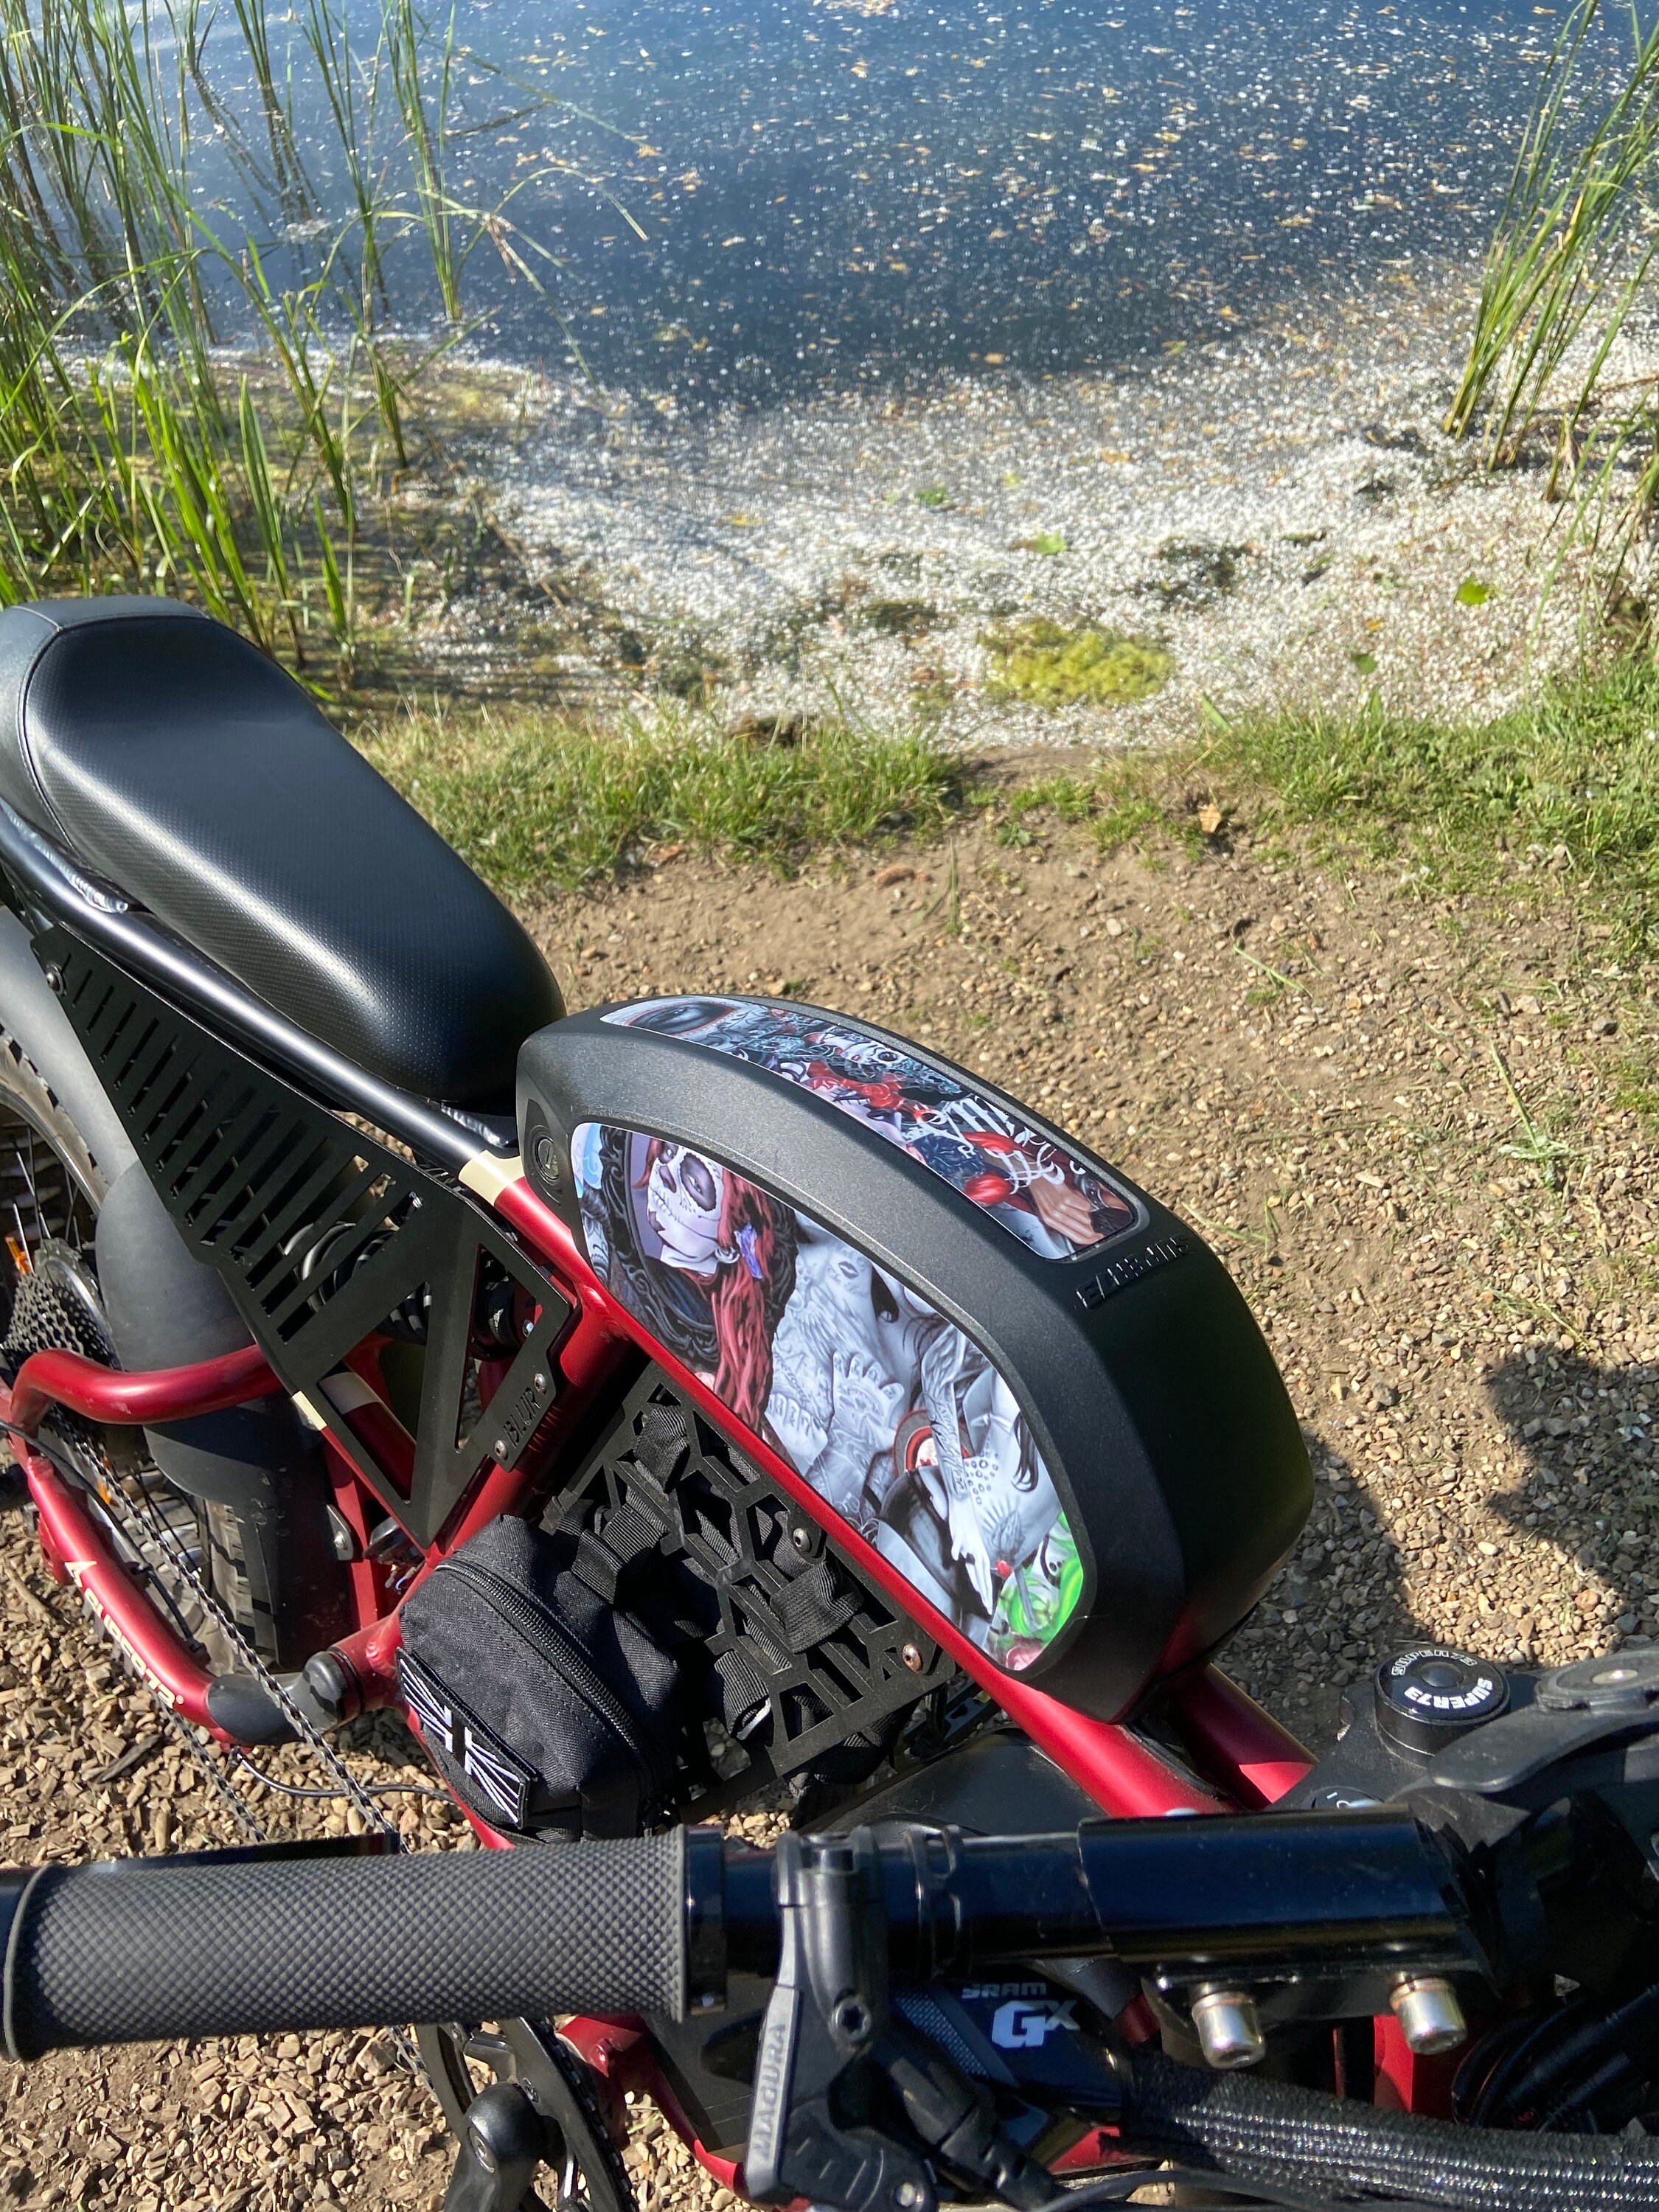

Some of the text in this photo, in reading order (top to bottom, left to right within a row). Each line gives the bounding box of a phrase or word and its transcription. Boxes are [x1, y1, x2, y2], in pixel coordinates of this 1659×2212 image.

[502, 1387, 542, 1449] BLUR
[1391, 1649, 1478, 1676] SUPER73
[1404, 1677, 1493, 1709] SUPER73
[961, 1982, 1047, 2000] SRAM
[991, 1999, 1081, 2049] GX
[753, 2023, 787, 2160] MAGURA
